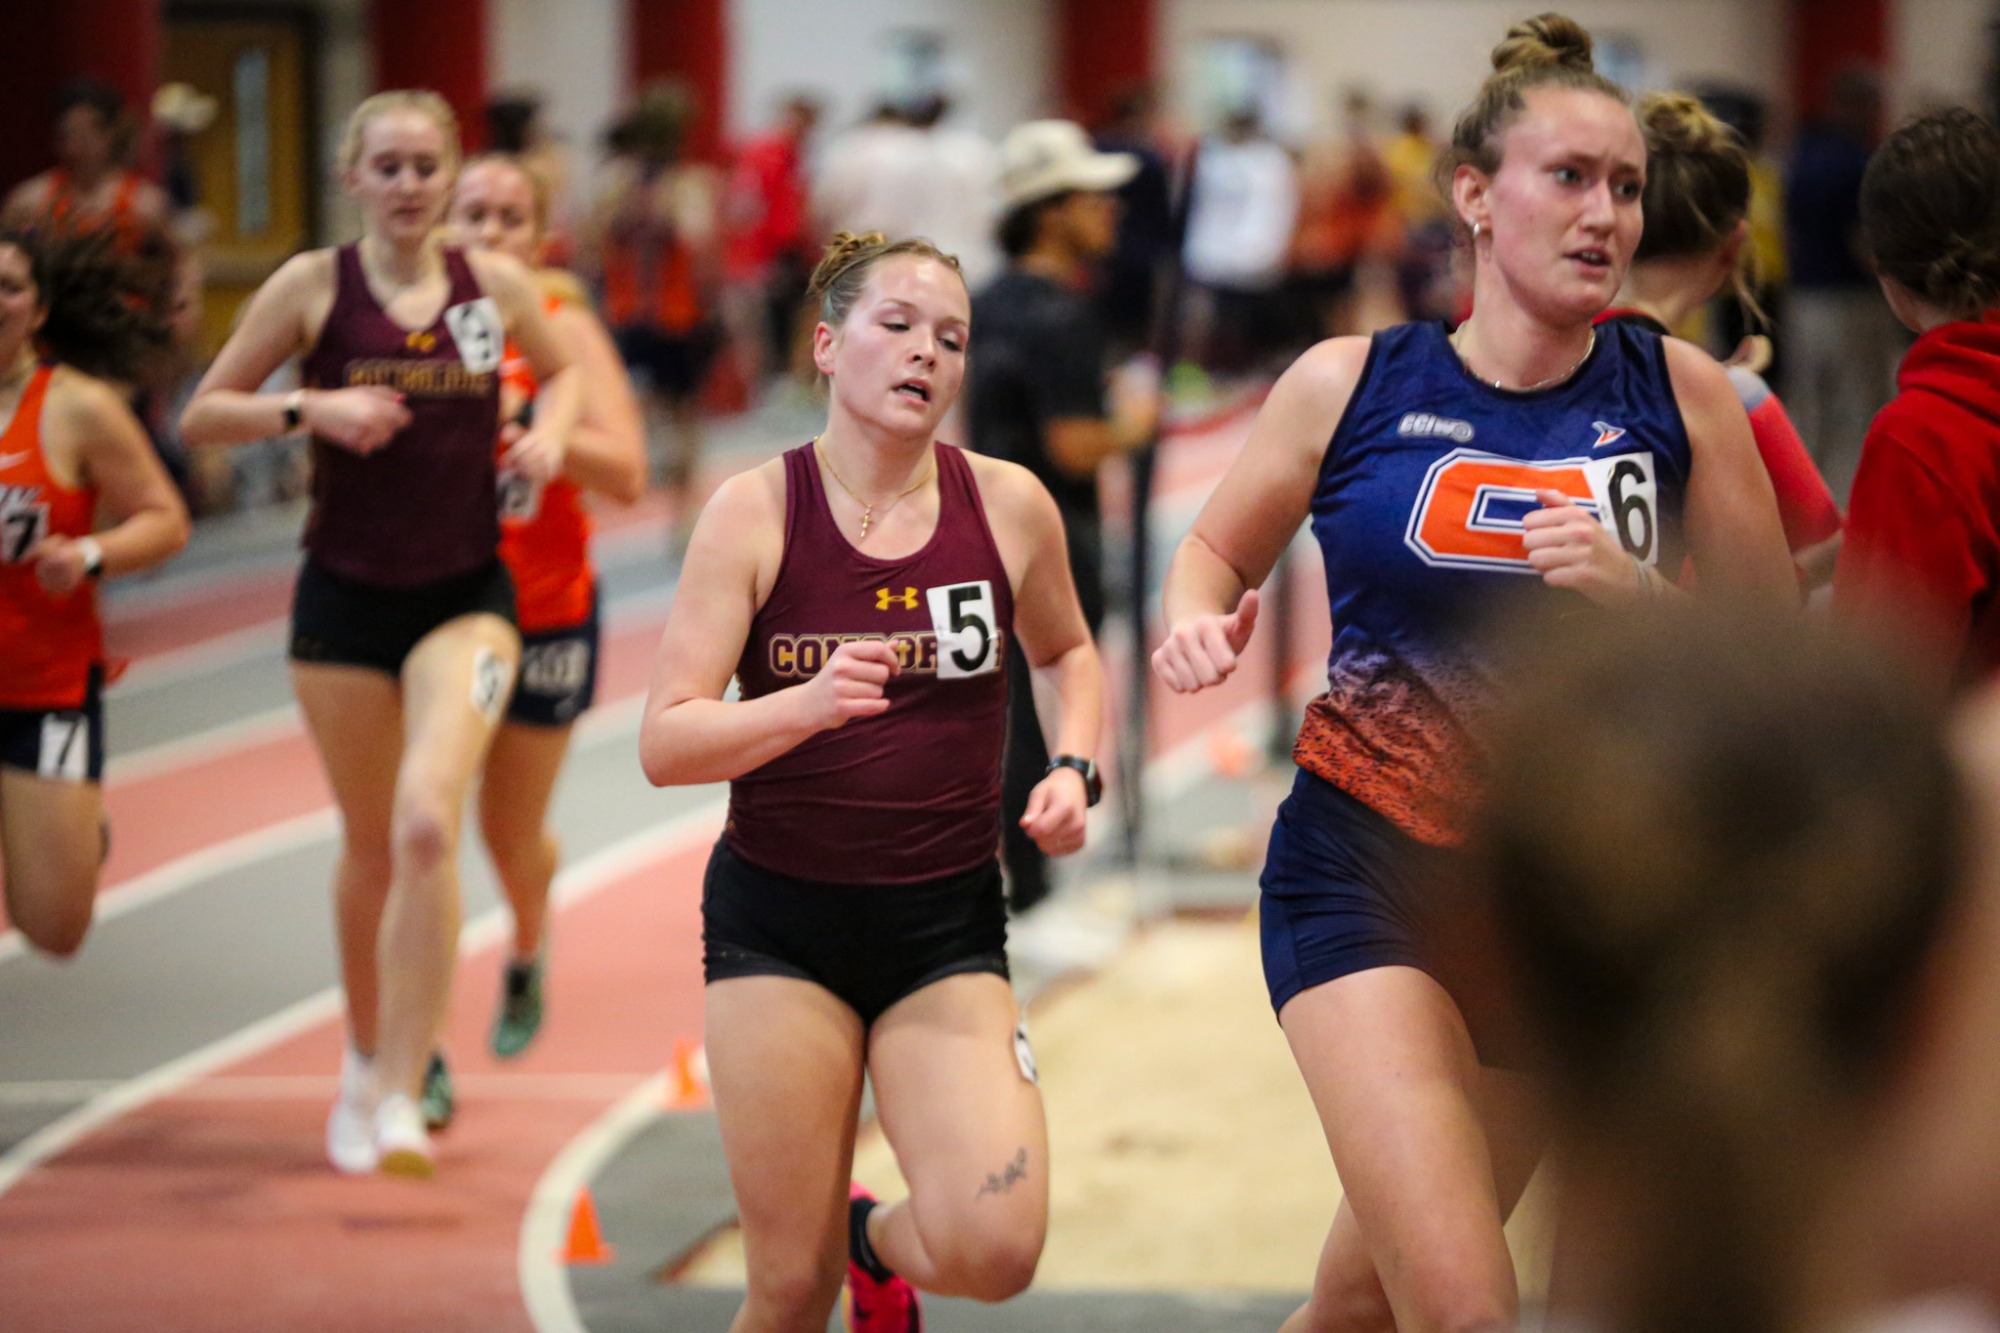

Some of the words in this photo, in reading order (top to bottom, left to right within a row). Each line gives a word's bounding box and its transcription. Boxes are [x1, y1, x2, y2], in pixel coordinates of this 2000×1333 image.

[7, 511, 39, 563] 7
[1608, 459, 1652, 561] 6
[947, 585, 990, 671] 5
[54, 709, 81, 777] 7
